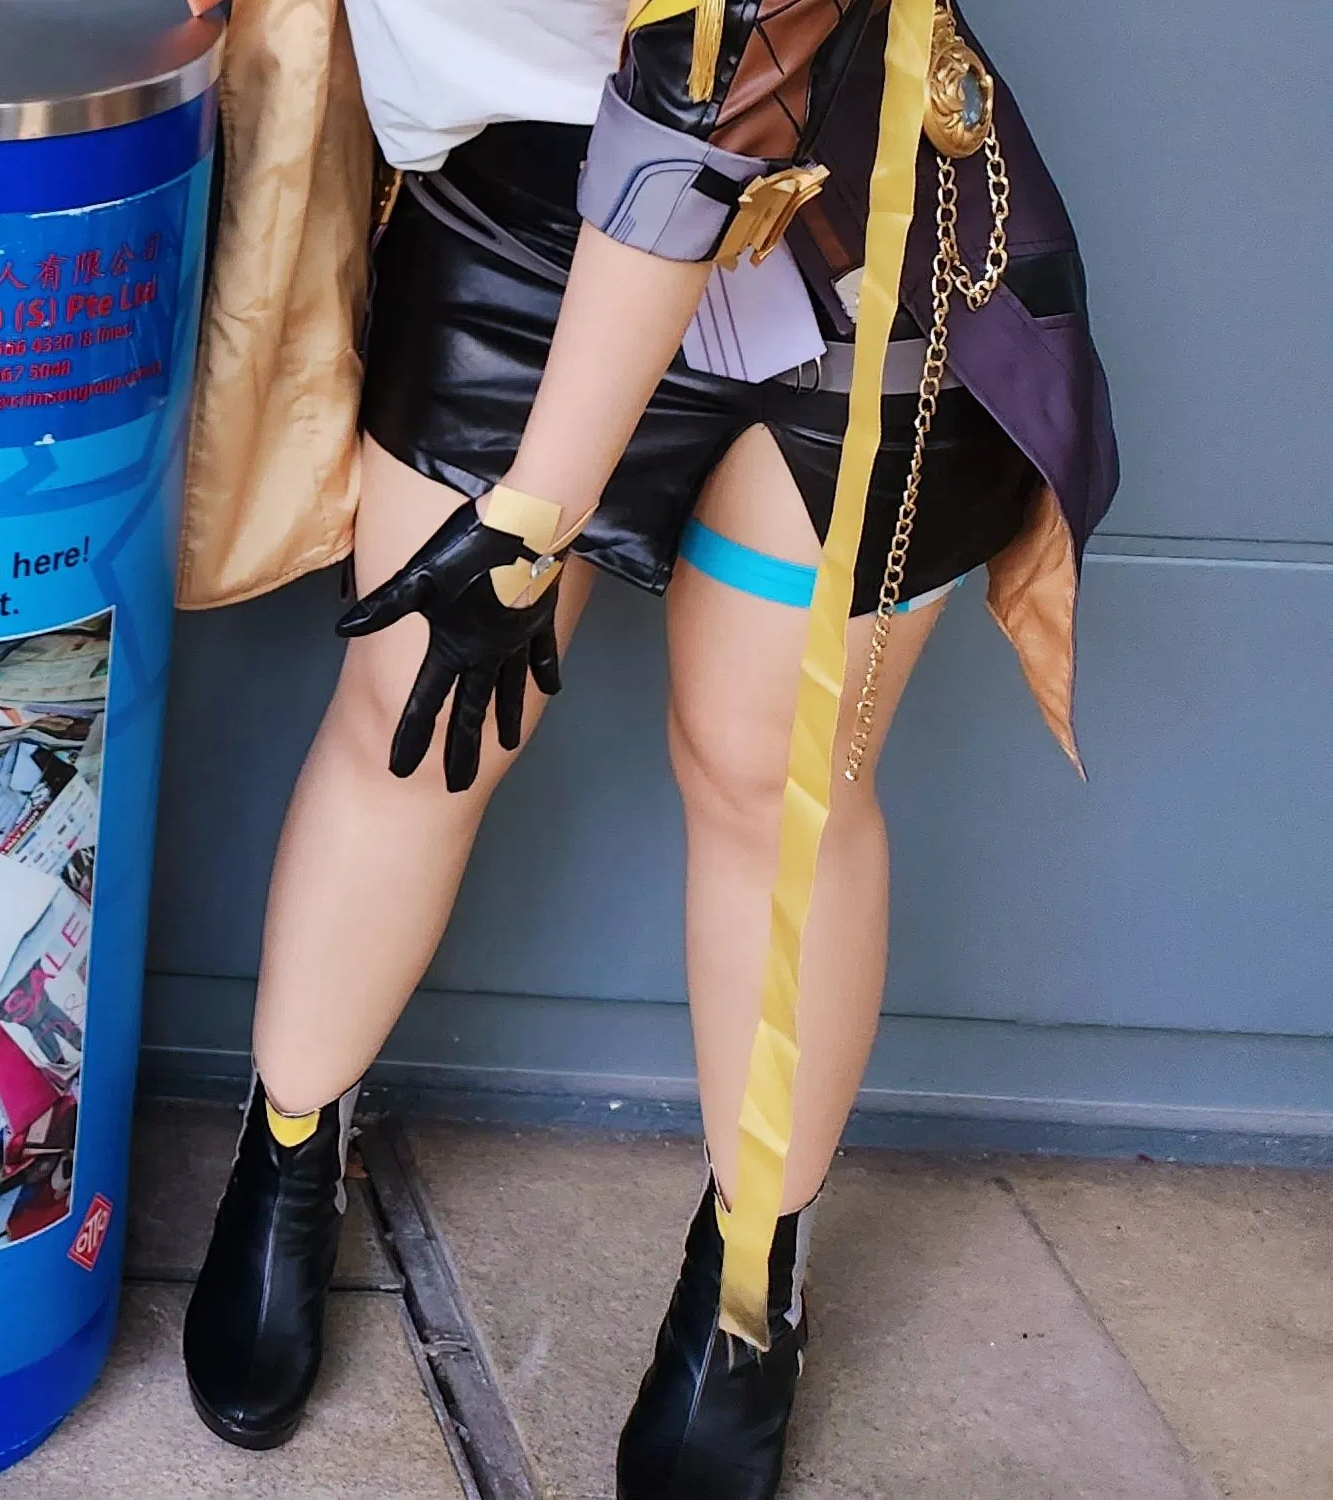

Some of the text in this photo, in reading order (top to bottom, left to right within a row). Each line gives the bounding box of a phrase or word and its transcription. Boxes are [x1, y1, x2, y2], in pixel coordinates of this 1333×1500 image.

[14, 296, 57, 332] (S)
[65, 292, 113, 323] Pte
[12, 536, 90, 579] here!
